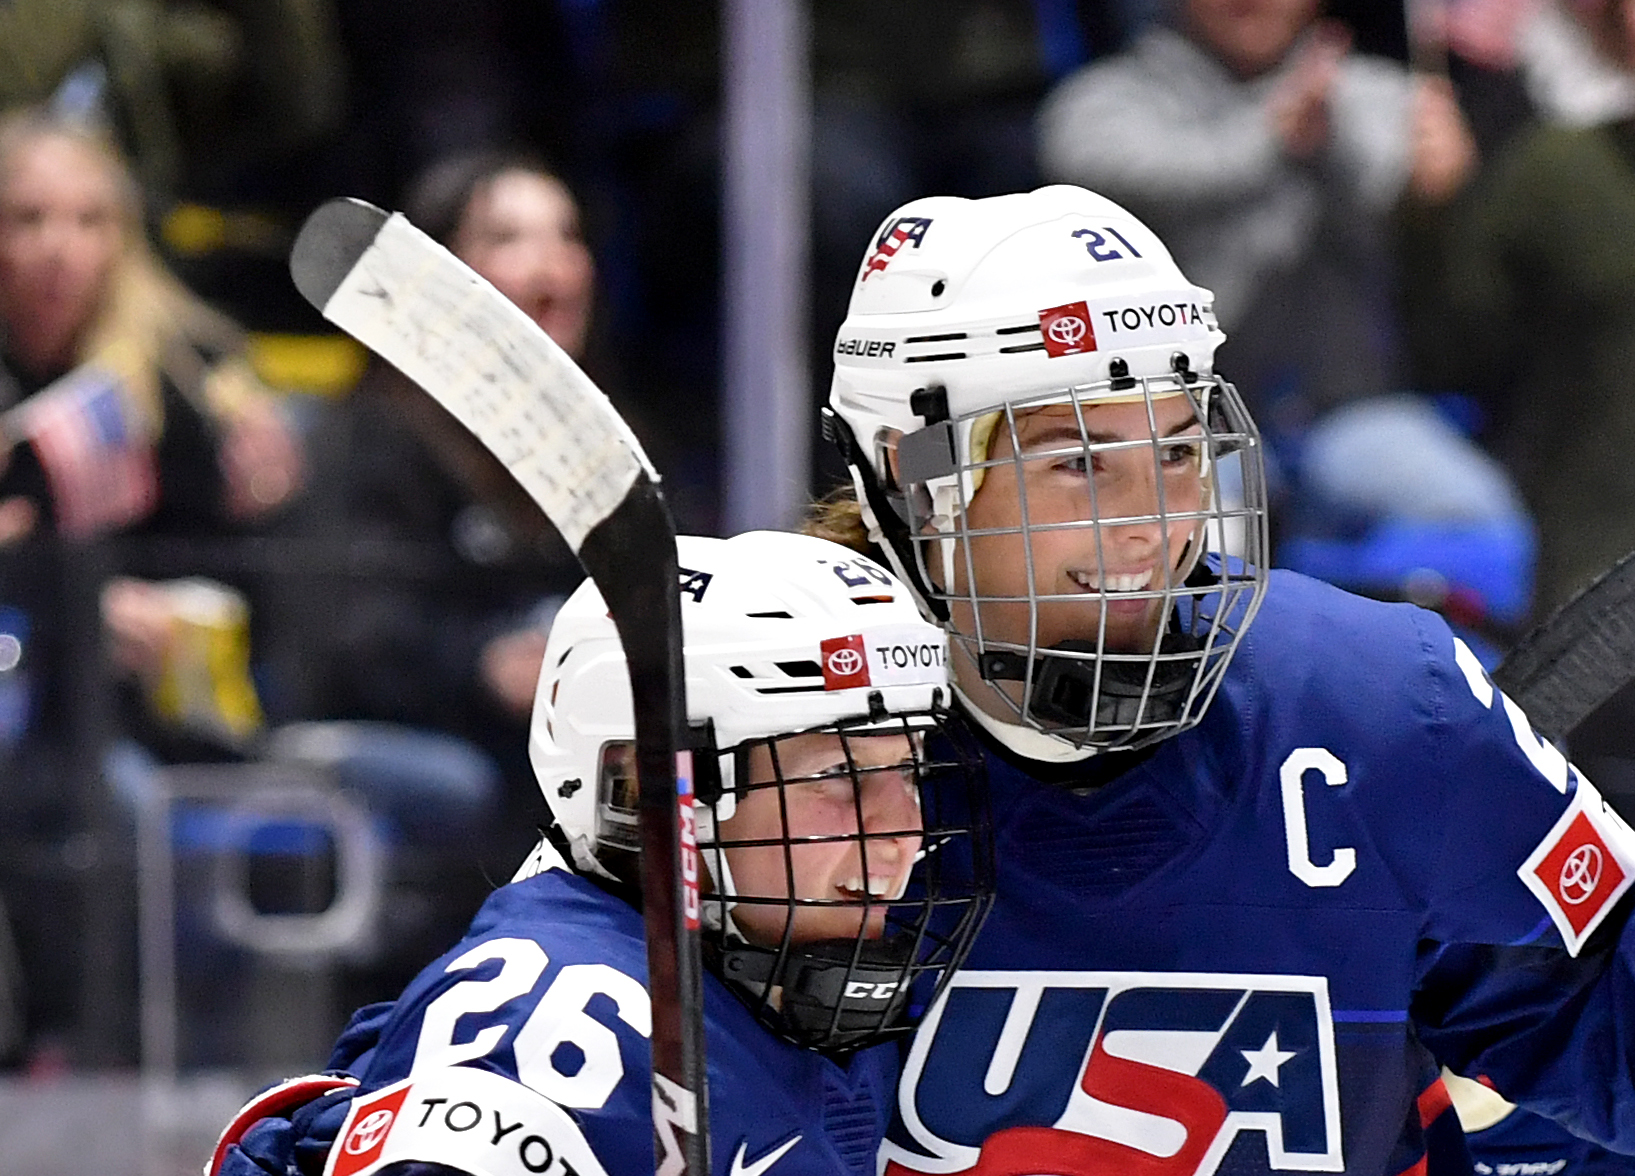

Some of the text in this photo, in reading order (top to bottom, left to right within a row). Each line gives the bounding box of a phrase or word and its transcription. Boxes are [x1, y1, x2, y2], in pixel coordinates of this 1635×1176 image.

[1071, 227, 1143, 263] 21
[1102, 303, 1204, 333] TOYOTA
[875, 644, 947, 670] TOYOT
[1277, 747, 1356, 888] C
[843, 975, 911, 1000] CC
[411, 937, 653, 1110] 26
